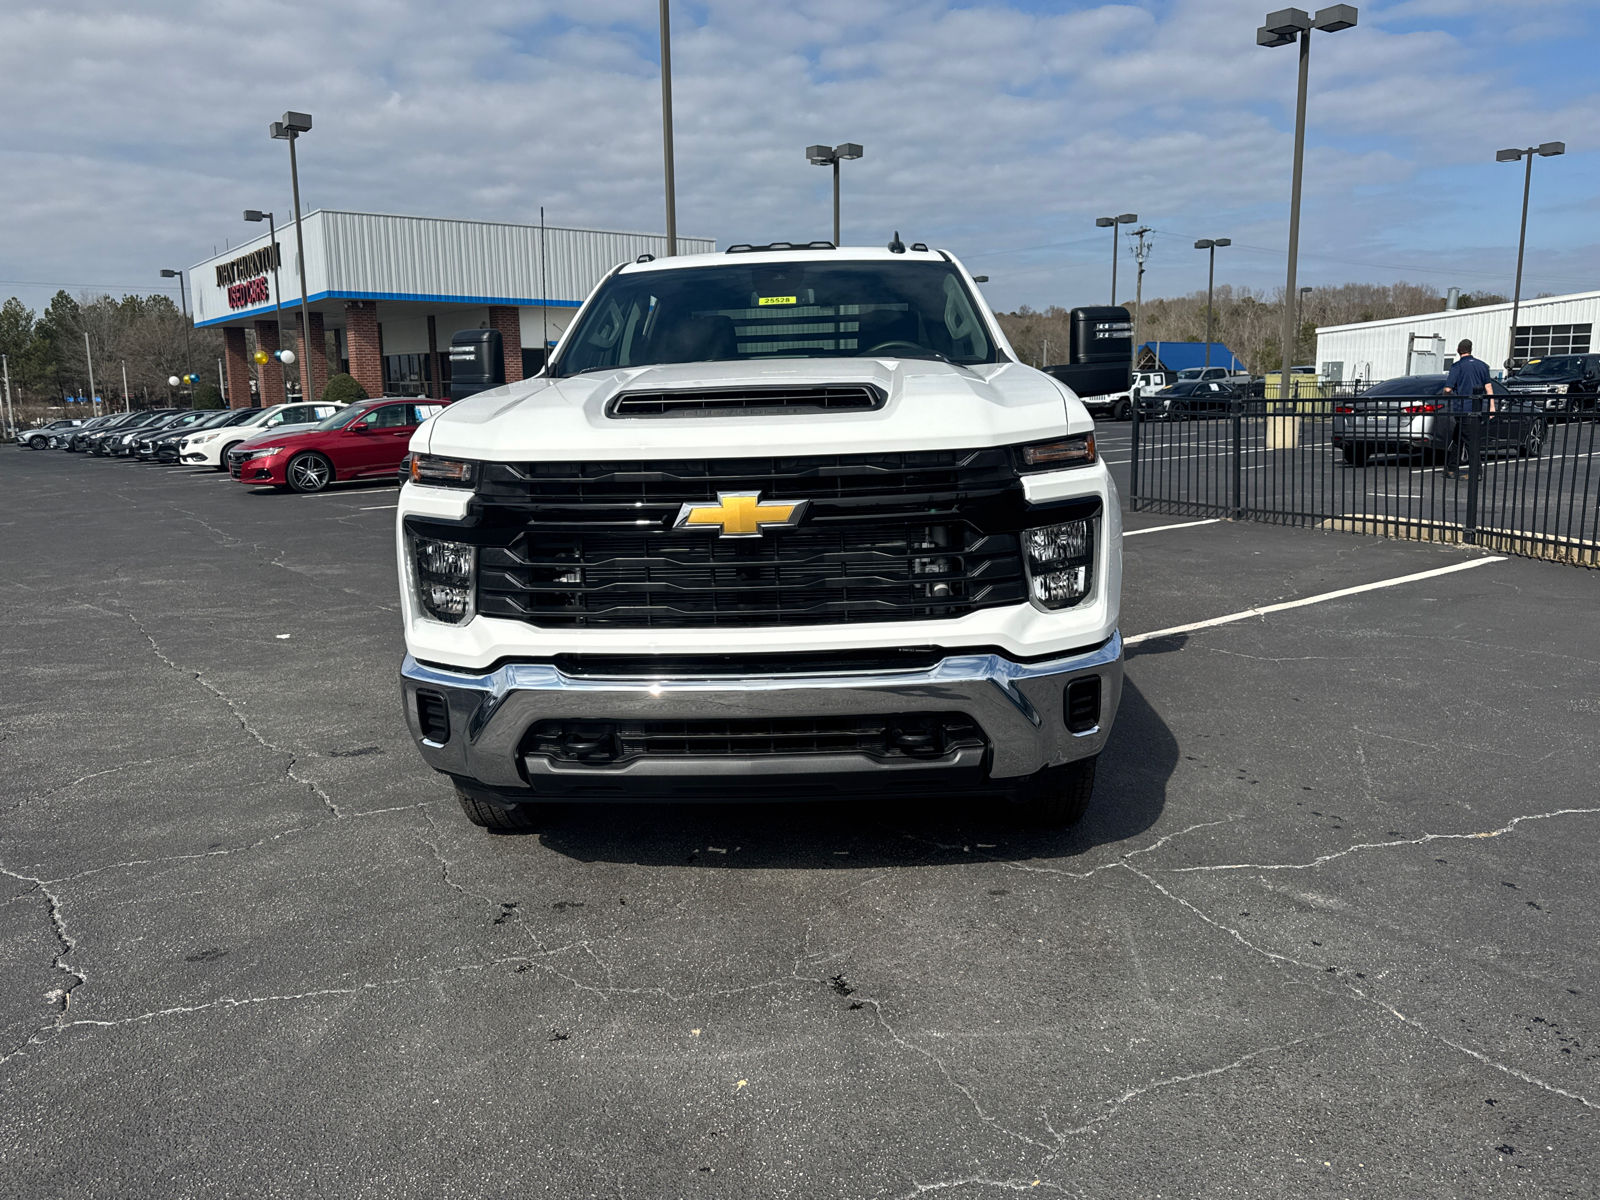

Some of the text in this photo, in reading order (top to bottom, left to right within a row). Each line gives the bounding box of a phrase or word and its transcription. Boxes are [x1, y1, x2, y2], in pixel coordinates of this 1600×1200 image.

[215, 262, 236, 287] JOHN
[228, 276, 269, 308] USED CARS
[683, 407, 800, 417] CHEVROLET
